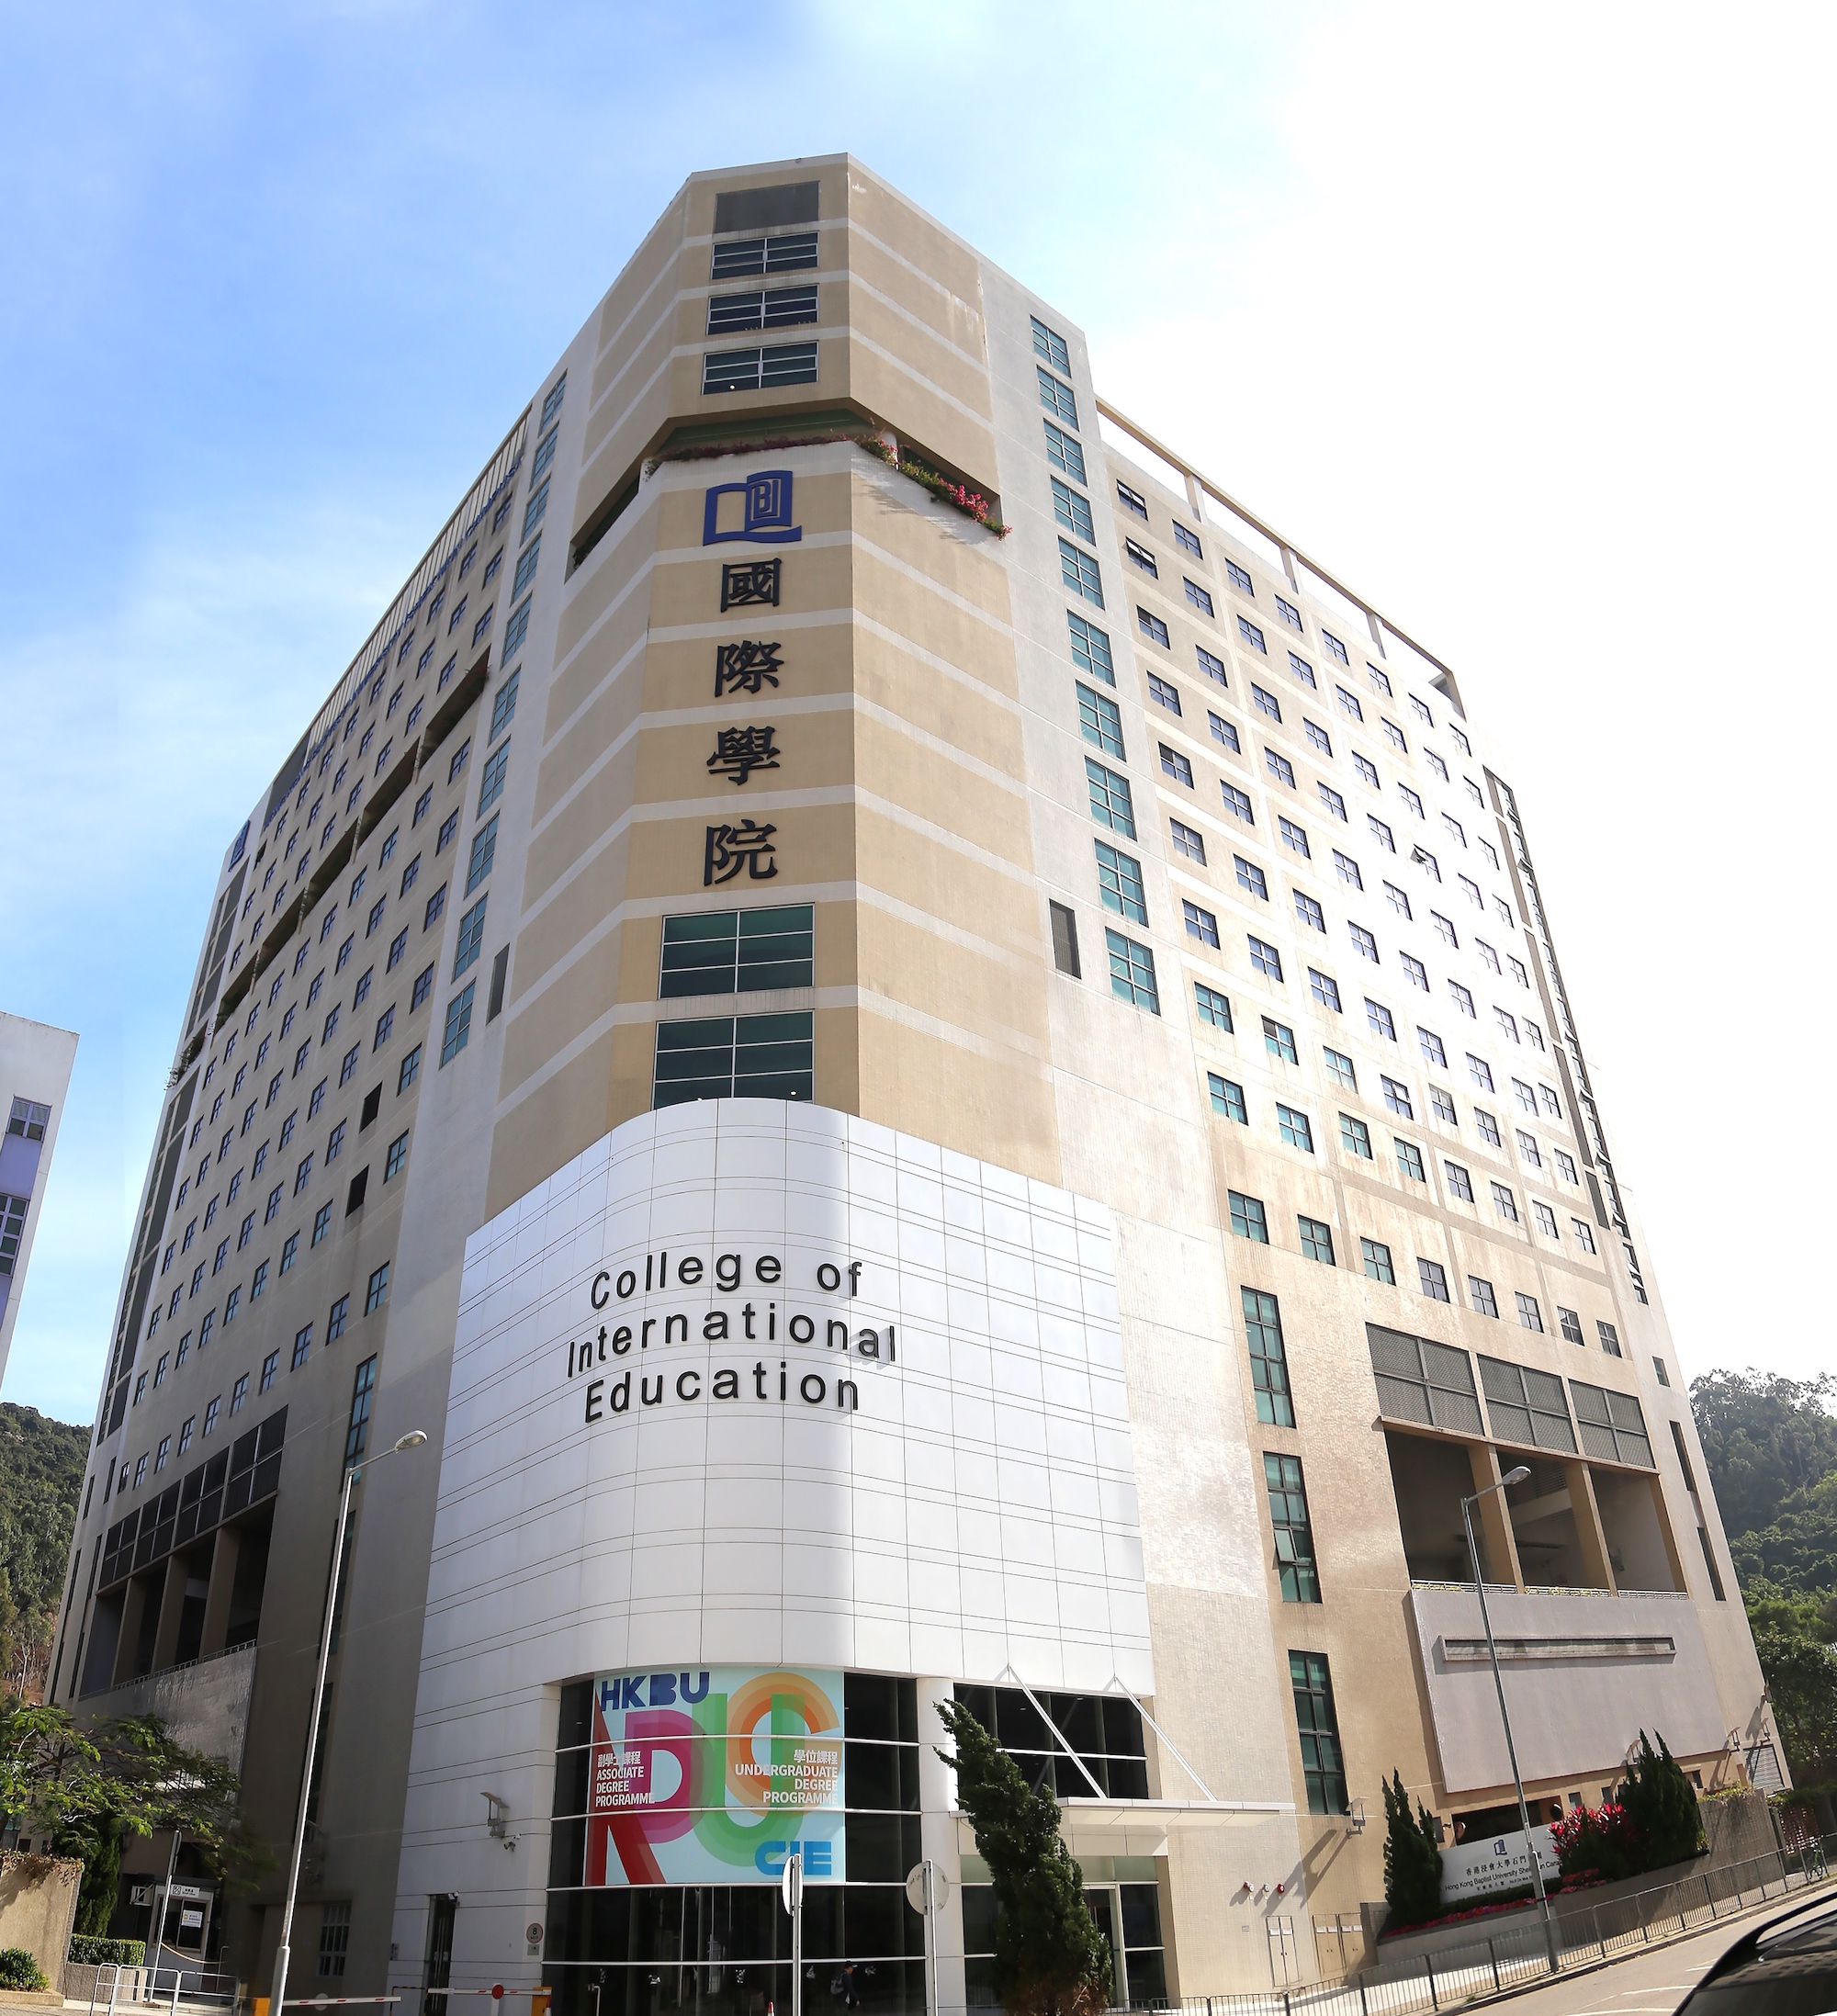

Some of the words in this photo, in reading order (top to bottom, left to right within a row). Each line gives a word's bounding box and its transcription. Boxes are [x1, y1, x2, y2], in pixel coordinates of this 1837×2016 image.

[703, 557, 784, 886] 國際學院
[591, 1251, 782, 1310] College
[817, 1261, 862, 1297] of
[567, 1302, 896, 1378] International
[585, 1361, 859, 1423] Education
[601, 1672, 710, 1712] HKBU
[794, 1749, 838, 1765] 學位課程
[596, 1765, 644, 1781] ASSOCIATE
[735, 1763, 838, 1778] UNDERGRADUATE
[596, 1780, 630, 1795] DEGREE
[795, 1778, 838, 1792] DEGREE
[595, 1792, 656, 1808] PROGRAMME
[762, 1791, 838, 1805] PROGRAMME
[1445, 1883, 1459, 1891] Hong
[532, 1927, 537, 1935] 8
